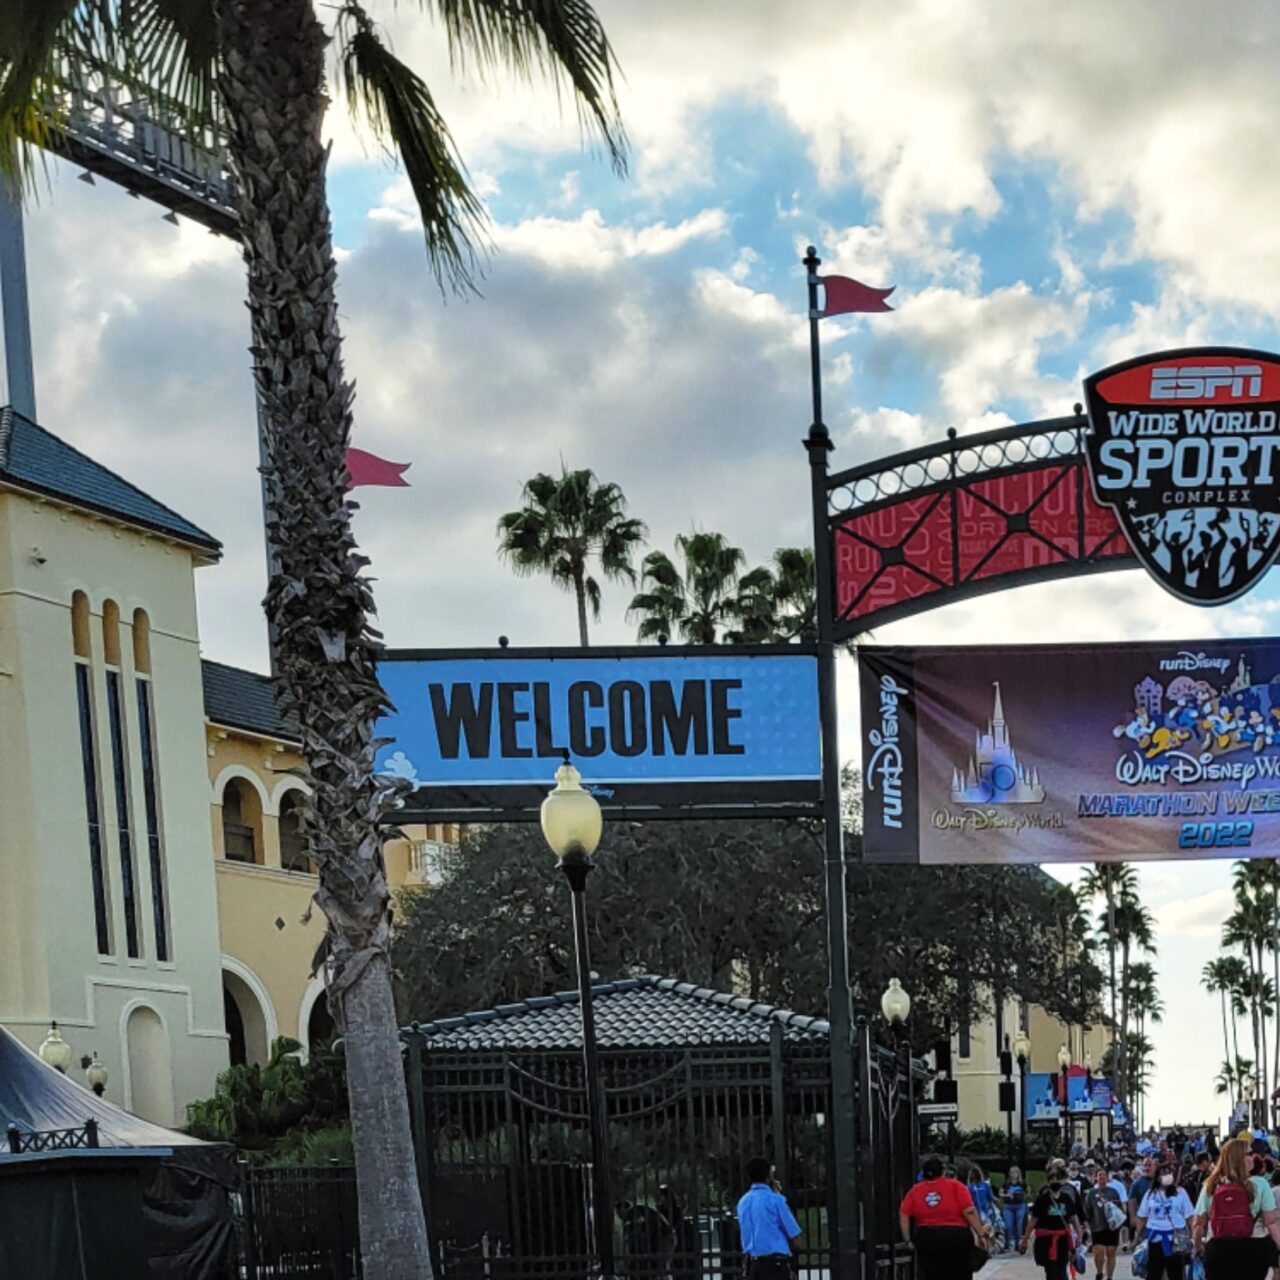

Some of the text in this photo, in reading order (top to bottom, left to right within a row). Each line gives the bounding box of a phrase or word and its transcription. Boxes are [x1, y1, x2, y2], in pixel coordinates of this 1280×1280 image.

[1149, 364, 1263, 400] ESPN
[1107, 411, 1180, 437] WIDE
[1182, 408, 1277, 435] WORLD
[1162, 490, 1252, 505] COMPLEX
[428, 678, 746, 760] WELCOME
[1077, 790, 1219, 818] MARATHON
[1178, 820, 1254, 848] 2022
